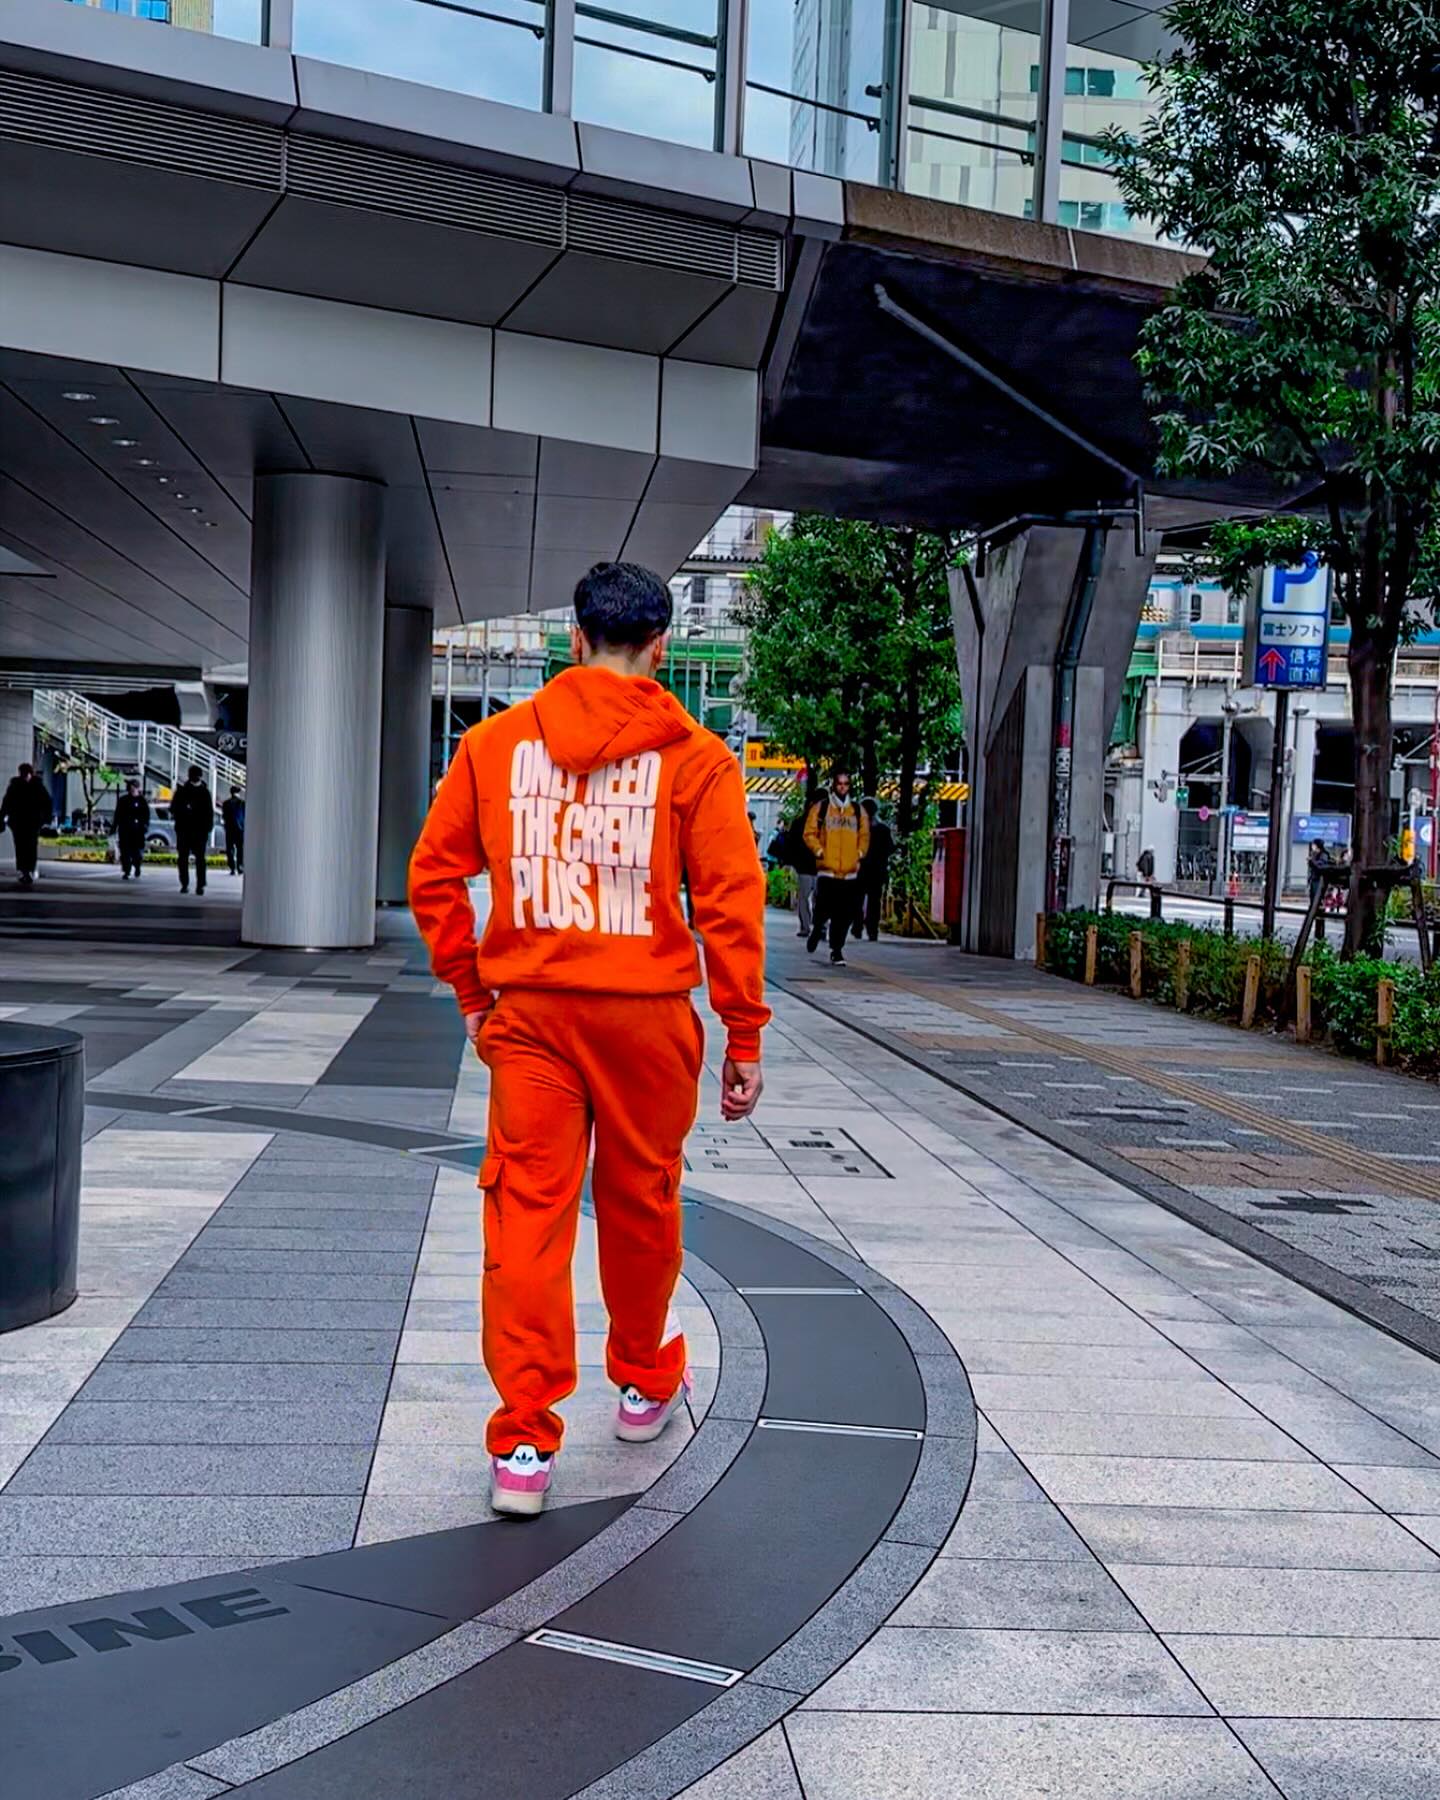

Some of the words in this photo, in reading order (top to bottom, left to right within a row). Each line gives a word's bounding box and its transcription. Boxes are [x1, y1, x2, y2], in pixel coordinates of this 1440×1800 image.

[1272, 549, 1319, 604] P
[1263, 622, 1321, 638] 富士ソフト
[1290, 648, 1321, 666] 信号
[1288, 667, 1320, 683] 直進
[584, 750, 662, 807] NEED
[508, 796, 562, 857] THE
[560, 802, 656, 869] CREW
[510, 856, 595, 932] PLUS
[597, 865, 654, 936] ME
